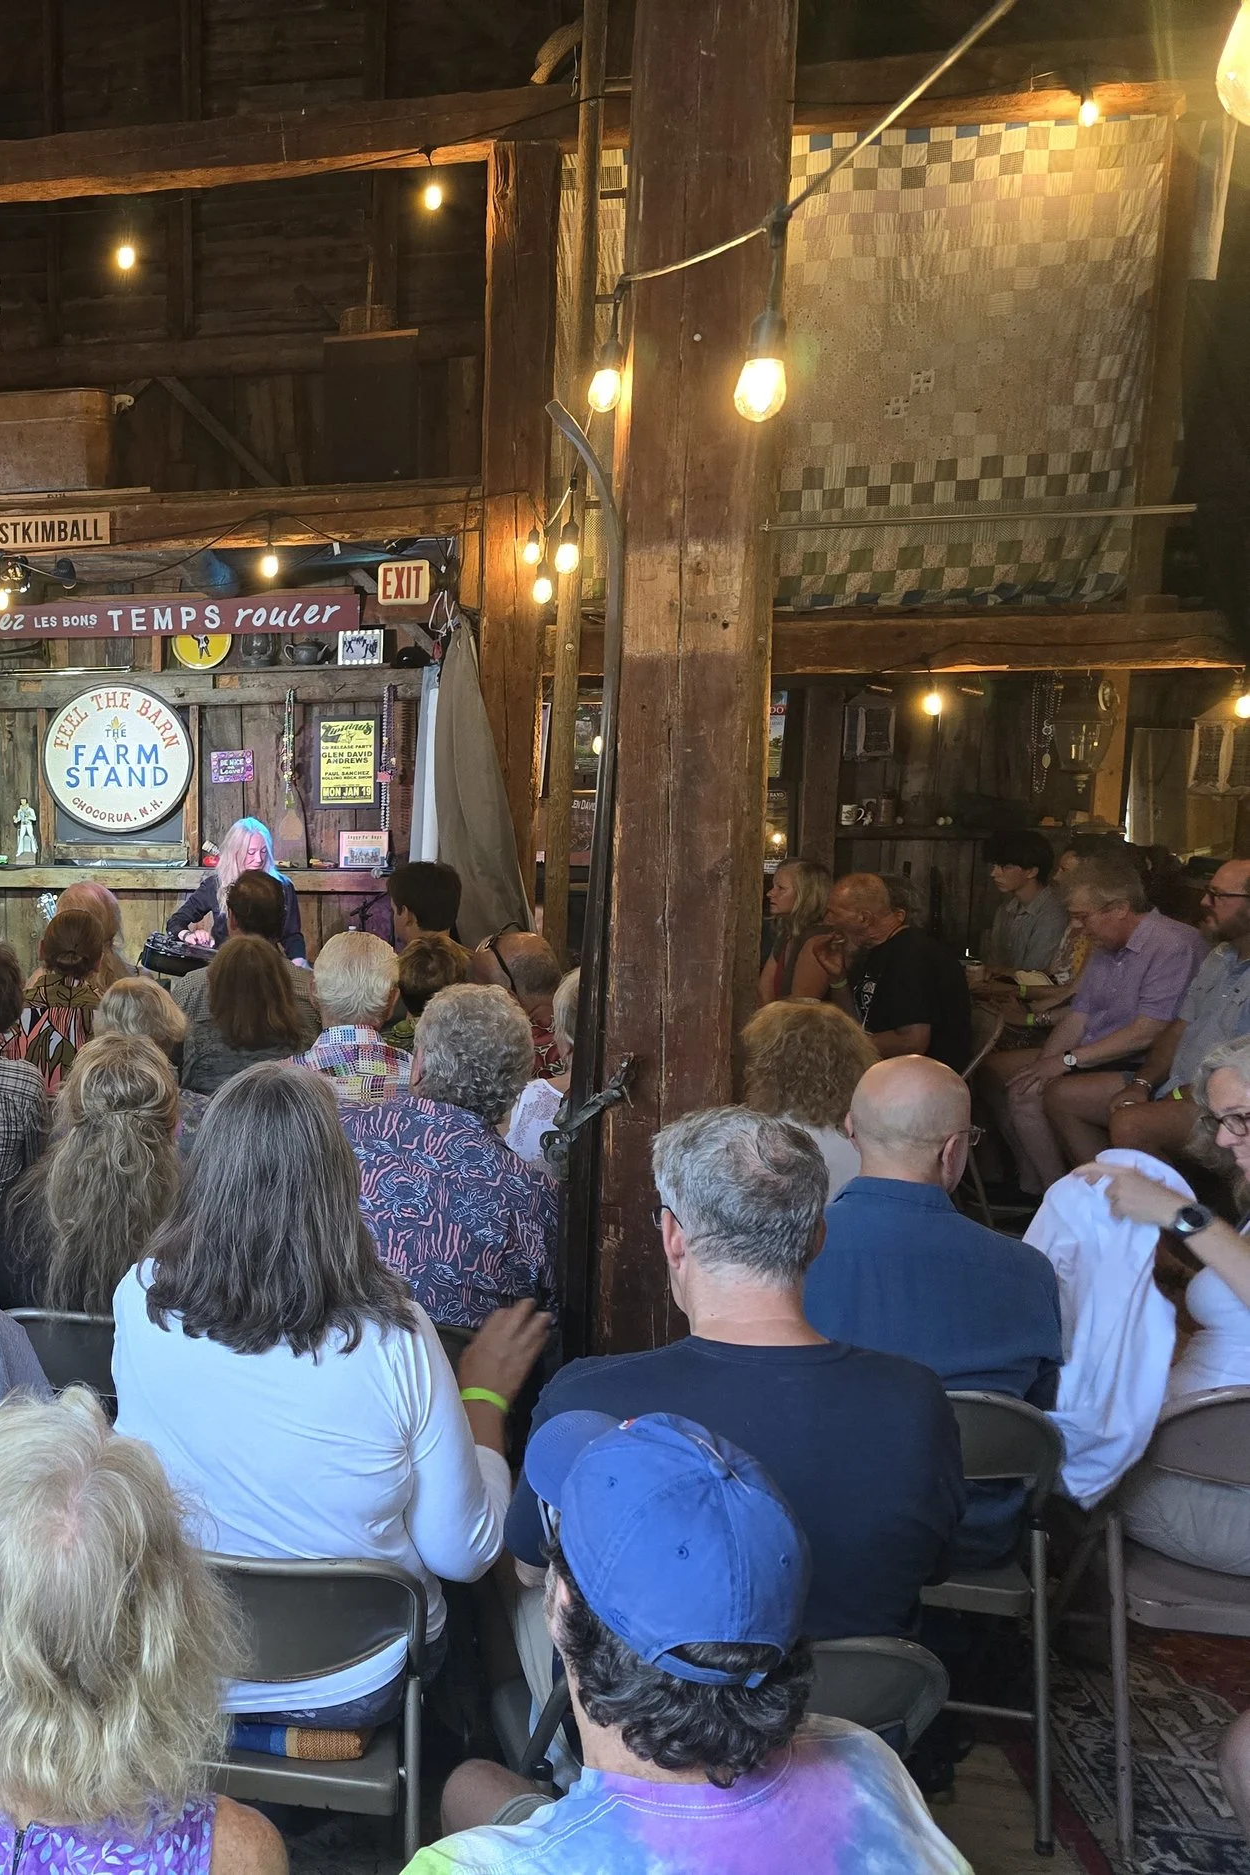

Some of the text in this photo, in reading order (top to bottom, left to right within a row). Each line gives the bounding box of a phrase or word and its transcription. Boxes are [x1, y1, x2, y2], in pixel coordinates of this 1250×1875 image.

[382, 565, 423, 600] EXIT
[34, 615, 58, 628] LES
[62, 614, 98, 628] BONS
[106, 604, 221, 632] TEMPS
[234, 603, 341, 628] rouler
[54, 691, 180, 750] FEEL THE BARN
[105, 728, 127, 738] THE
[74, 744, 160, 765] FARM
[322, 750, 373, 759] GLEN DAVID
[326, 757, 369, 765] ANDREWS
[65, 766, 169, 788] STAND
[323, 786, 371, 797] MON JAN 19
[139, 799, 163, 818] N.H.
